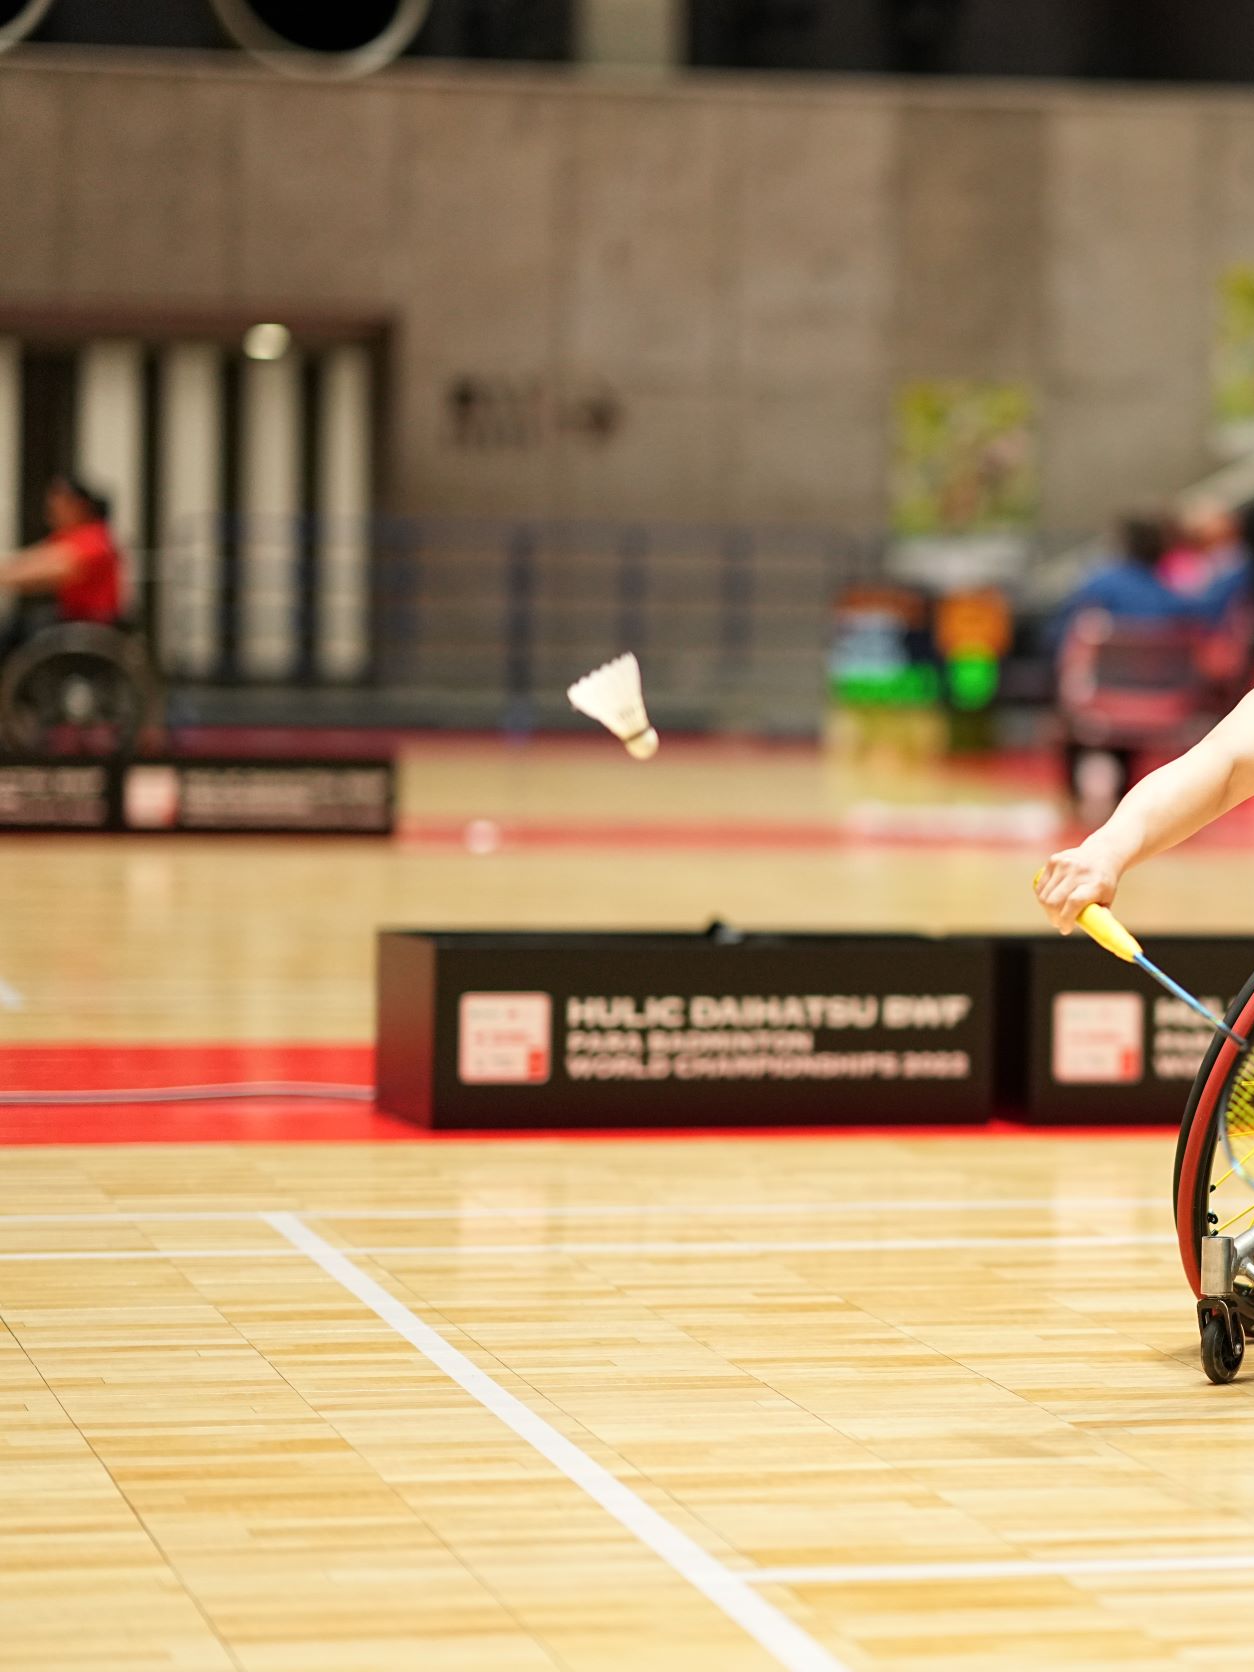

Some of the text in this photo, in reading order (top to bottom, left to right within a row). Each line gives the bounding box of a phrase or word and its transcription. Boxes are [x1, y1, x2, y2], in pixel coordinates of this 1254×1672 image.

[566, 995, 970, 1029] HULIC DAIHATSU BWF
